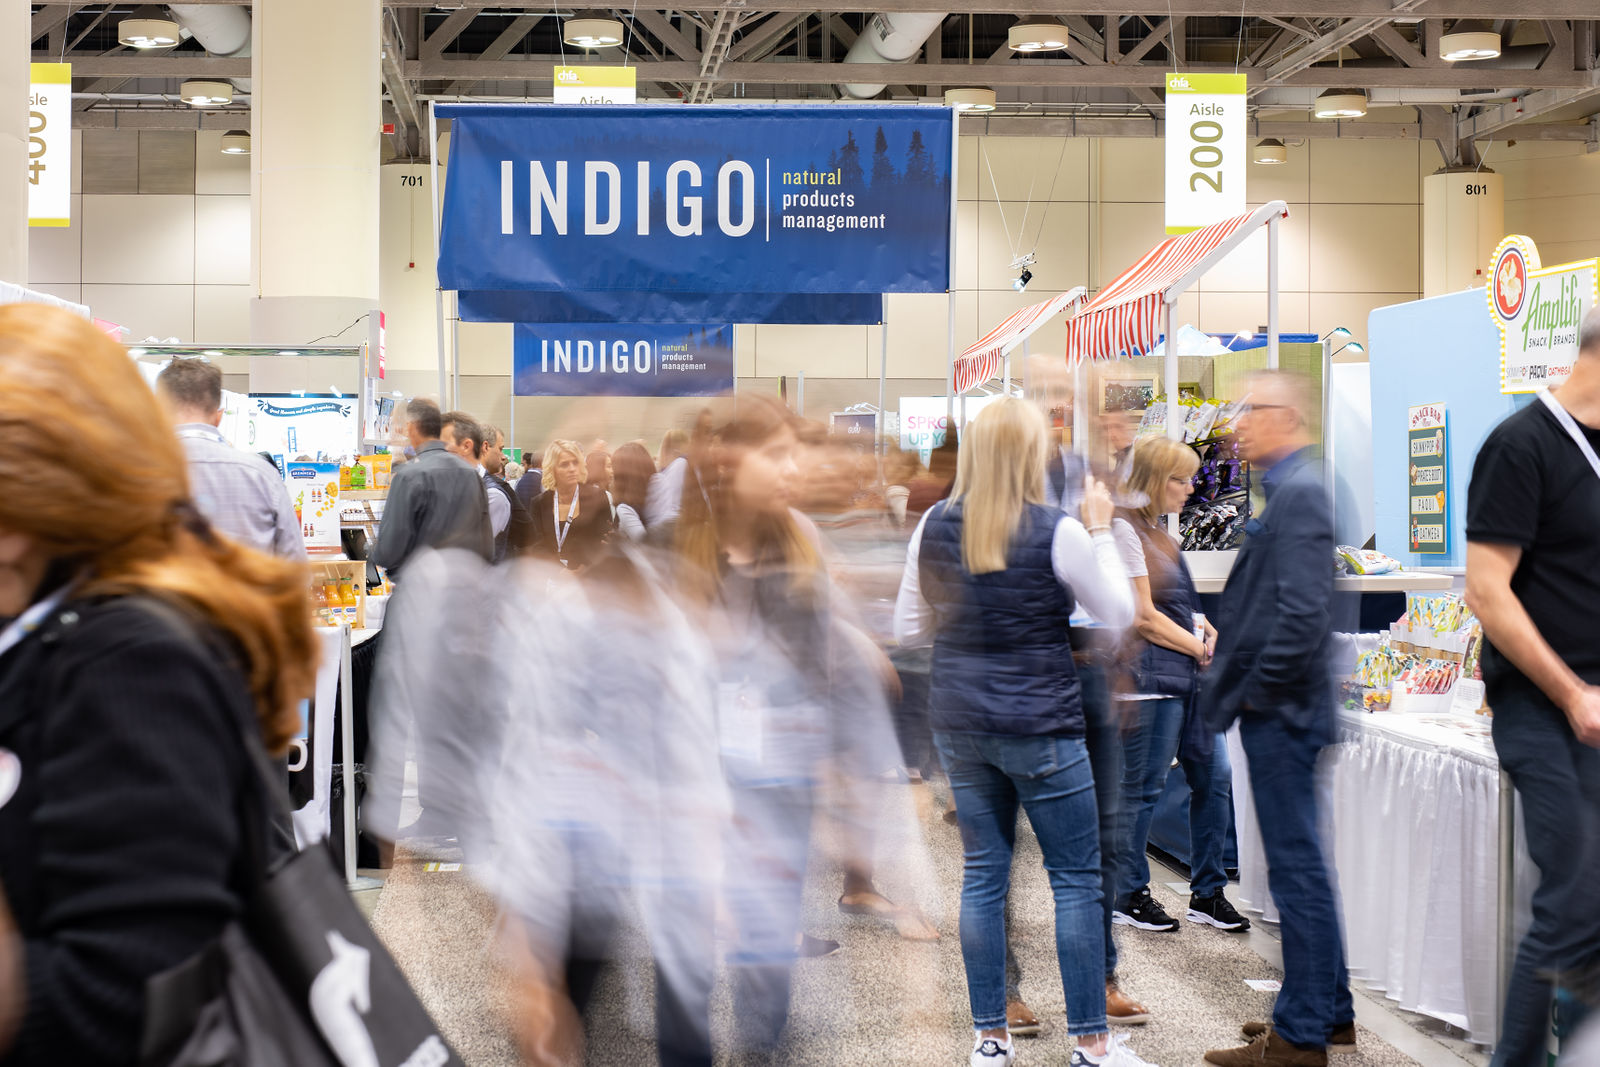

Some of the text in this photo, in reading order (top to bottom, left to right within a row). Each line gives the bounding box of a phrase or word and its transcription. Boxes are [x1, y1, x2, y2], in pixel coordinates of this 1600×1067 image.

[29, 93, 48, 106] sle
[1190, 103, 1224, 116] Aisle
[1190, 120, 1224, 193] 200
[401, 175, 423, 187] 701
[783, 168, 842, 185] natural
[1465, 184, 1487, 195] 801
[501, 160, 755, 237] INDIGO
[783, 189, 855, 210] products
[782, 213, 886, 233] management
[1521, 274, 1582, 352] Amplify
[1528, 333, 1576, 348] SNACK BRANDS
[661, 344, 688, 352] natural
[541, 339, 651, 374] INDIGO
[661, 353, 694, 362] products
[661, 362, 707, 372] management
[908, 432, 929, 446] UP
